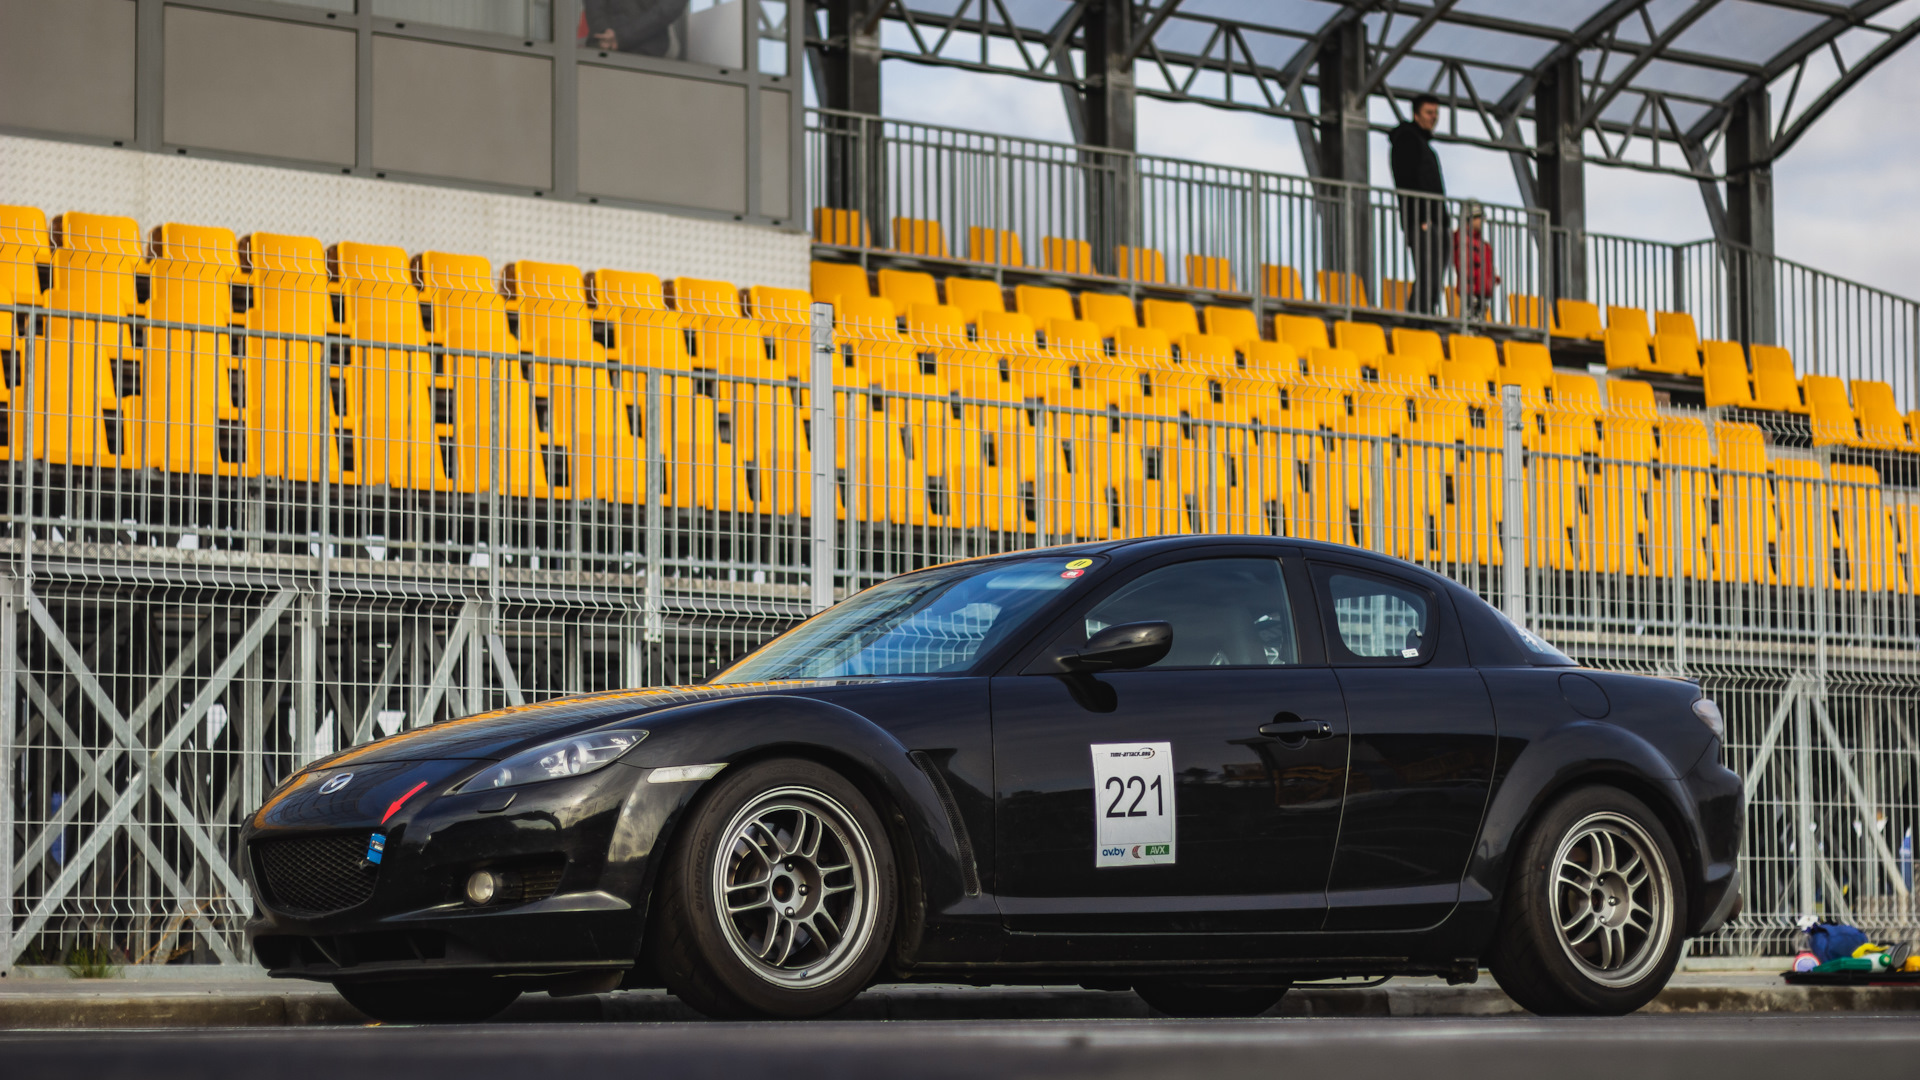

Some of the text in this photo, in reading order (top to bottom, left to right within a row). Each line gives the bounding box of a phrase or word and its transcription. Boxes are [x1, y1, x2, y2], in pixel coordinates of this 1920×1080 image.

[1105, 774, 1163, 818] 221
[1102, 847, 1126, 858] av.by
[1150, 845, 1166, 855] AVX
